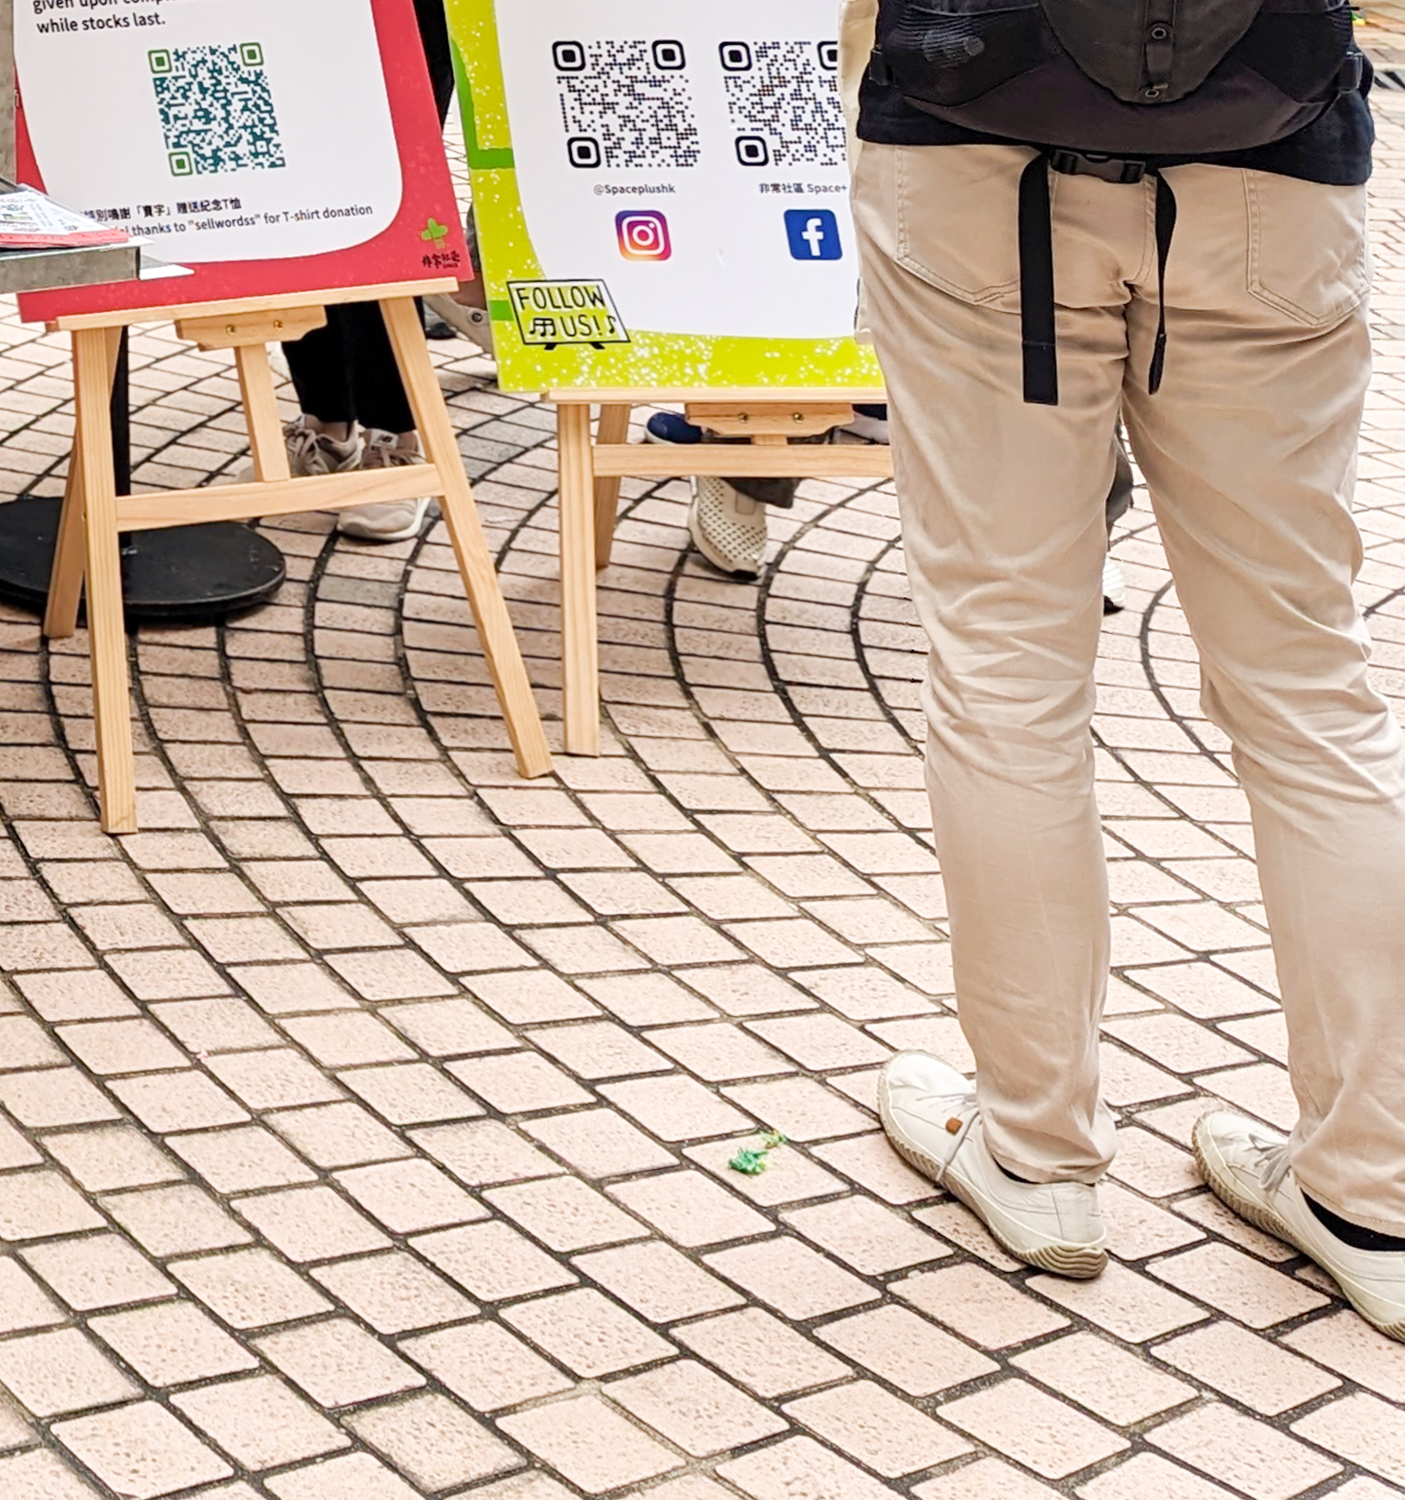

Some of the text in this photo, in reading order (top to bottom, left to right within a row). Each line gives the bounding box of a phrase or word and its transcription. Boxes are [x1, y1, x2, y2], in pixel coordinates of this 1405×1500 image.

[37, 12, 165, 34] while stocks last.
[594, 183, 675, 195] @Spaceplushk
[759, 183, 847, 194] 非常社區 Space+
[132, 223, 172, 236] thanks
[174, 222, 186, 232] to
[264, 212, 280, 224] for
[282, 209, 320, 223] T-shirt
[323, 203, 373, 220] donation
[517, 285, 605, 310] FOLLOW
